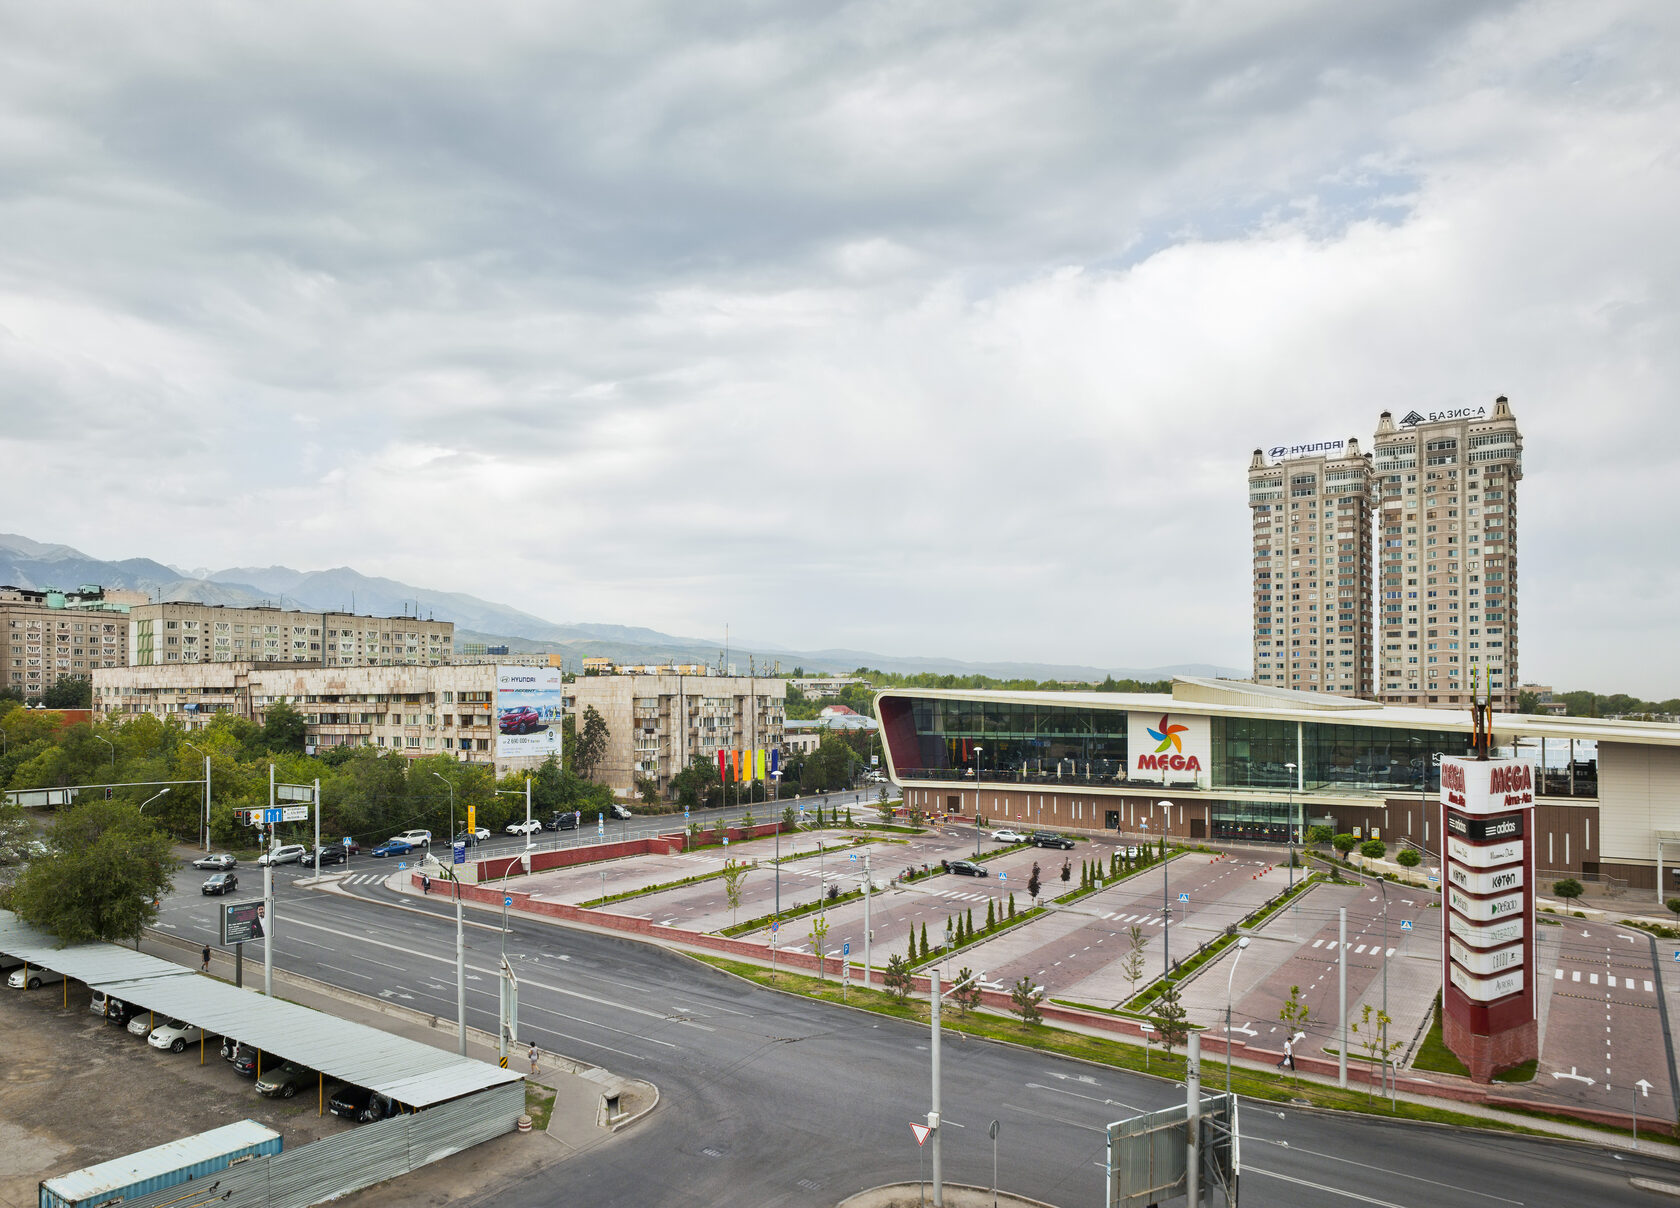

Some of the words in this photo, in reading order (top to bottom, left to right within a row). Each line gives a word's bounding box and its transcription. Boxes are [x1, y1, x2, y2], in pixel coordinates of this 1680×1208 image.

[1429, 406, 1486, 421] БАЗИС-А
[1291, 440, 1344, 454] HYUNDAI
[1137, 754, 1202, 771] MEGA
[1441, 763, 1466, 794] MEGA
[1489, 764, 1532, 795] MEGA
[1504, 792, 1532, 807] Alma-Ata
[1454, 818, 1467, 834] adidas
[1496, 820, 1516, 835] adidas
[1492, 872, 1516, 889] KOTON
